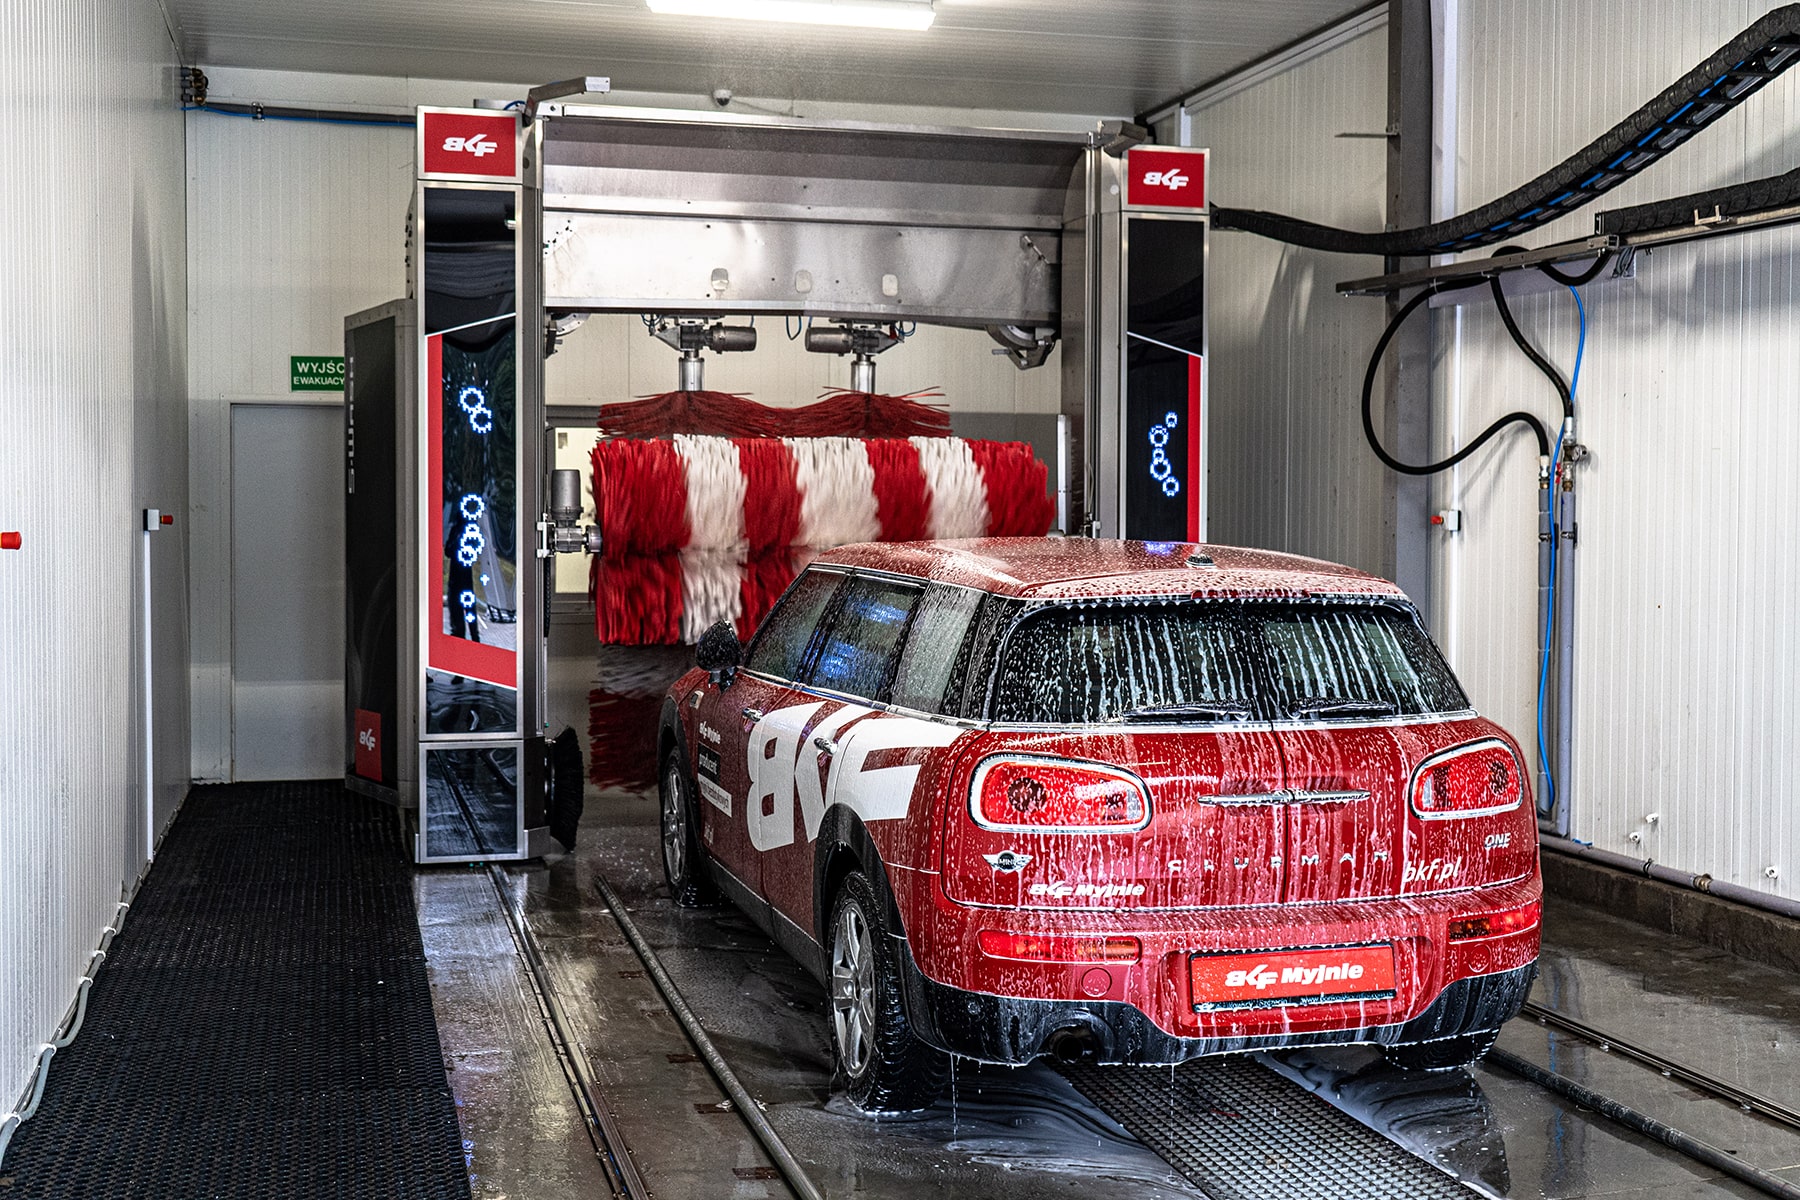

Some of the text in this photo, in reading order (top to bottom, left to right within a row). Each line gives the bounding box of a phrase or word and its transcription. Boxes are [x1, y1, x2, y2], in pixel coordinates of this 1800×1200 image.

[442, 133, 498, 157] BKF
[1143, 168, 1189, 190] BKF
[359, 728, 376, 751] BKF
[746, 700, 967, 852] BKF
[1484, 832, 1511, 848] ONE
[1403, 856, 1462, 883] bkf.pl
[1029, 880, 1146, 898] BKF Myjnie
[1225, 962, 1364, 989] BKF Myjnie
